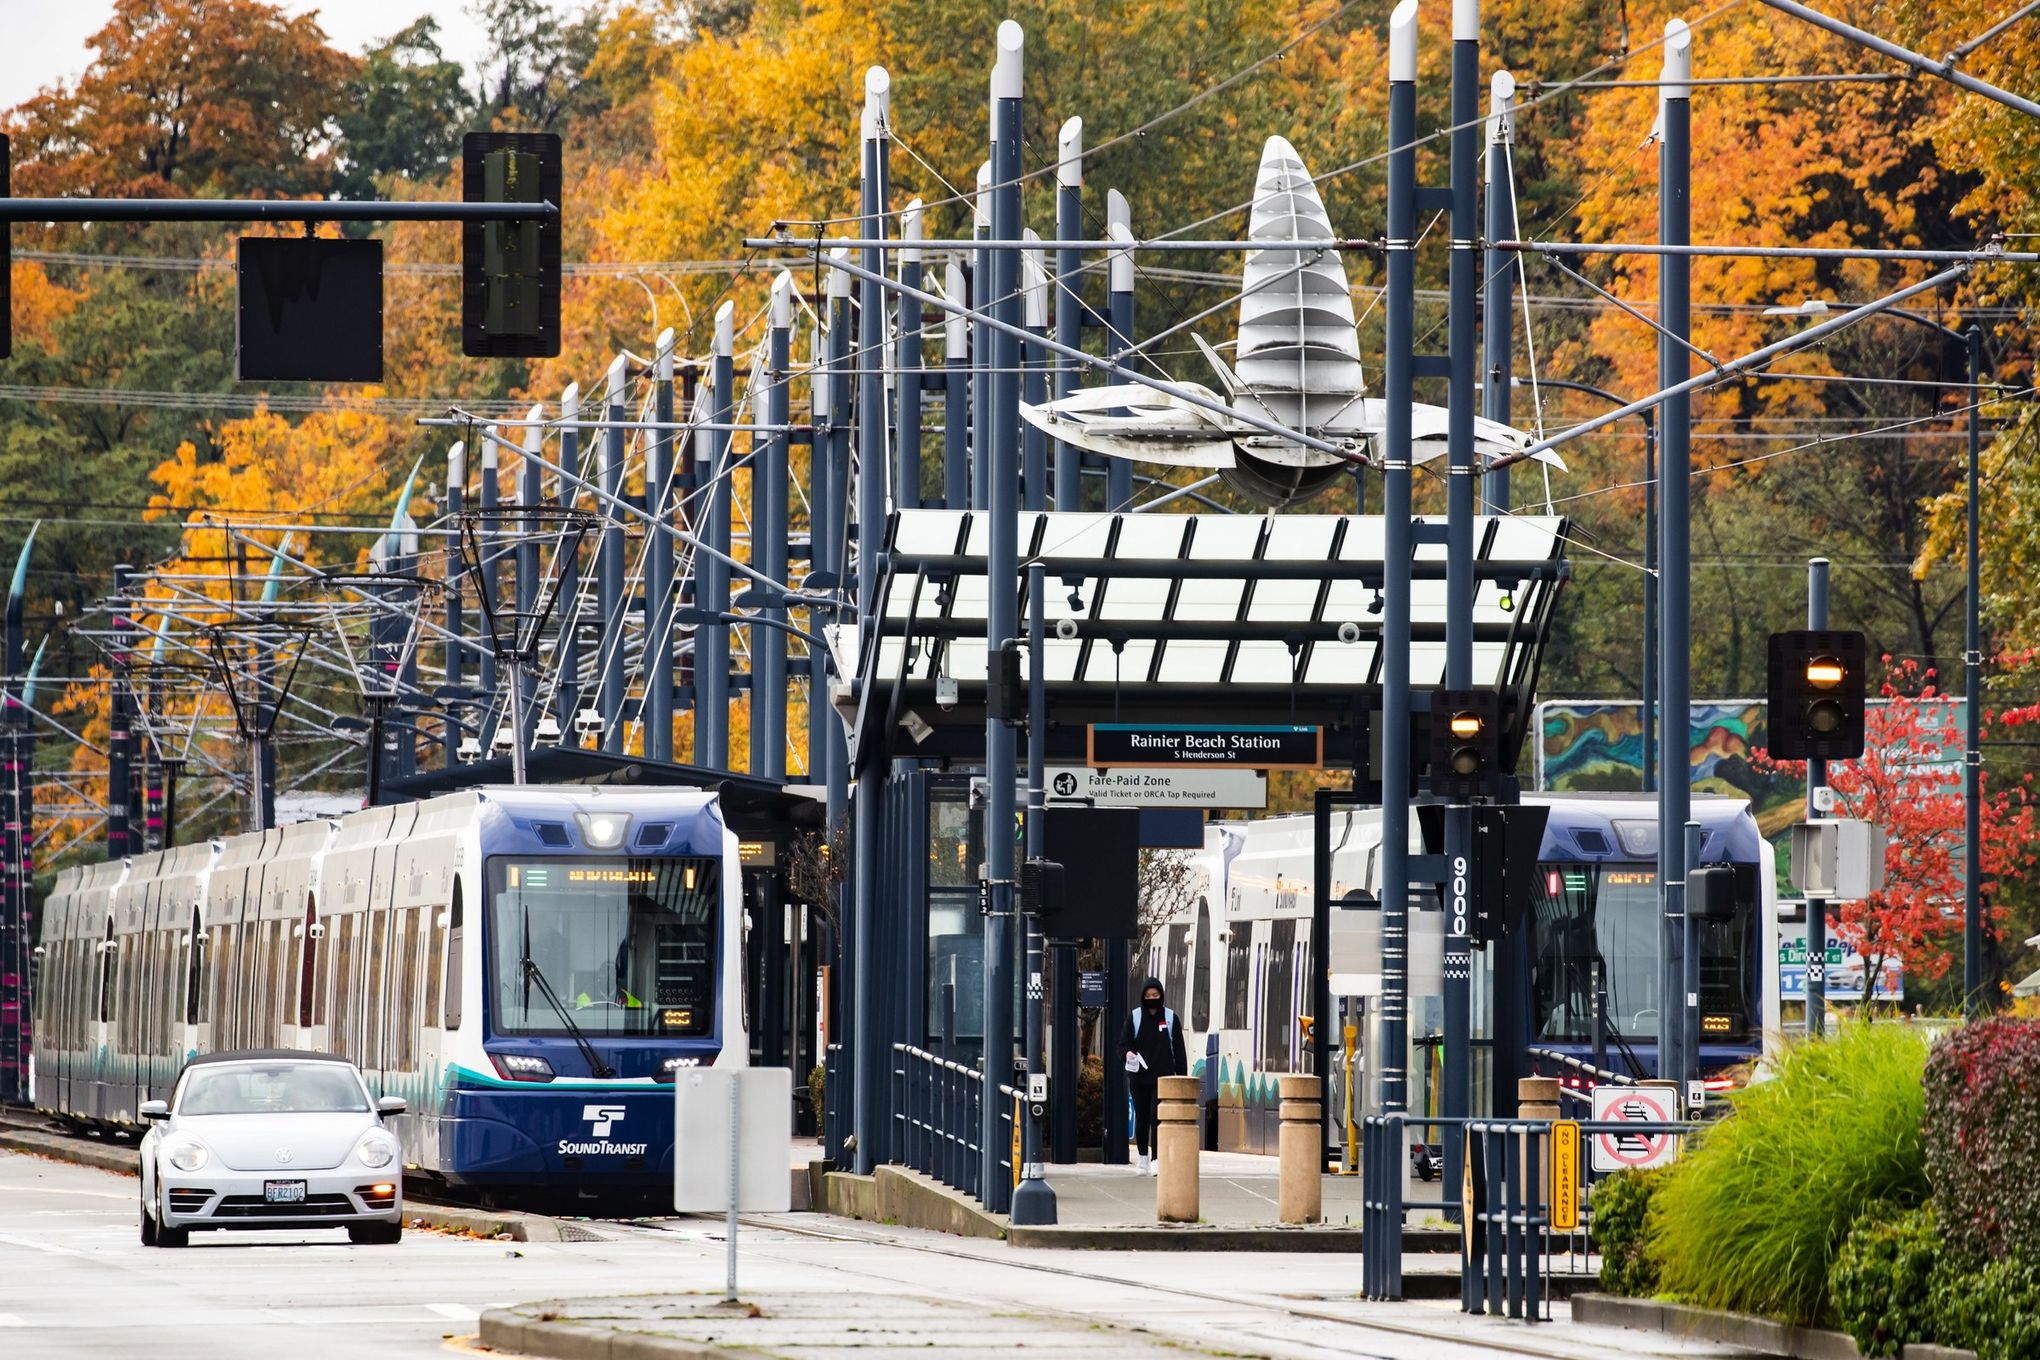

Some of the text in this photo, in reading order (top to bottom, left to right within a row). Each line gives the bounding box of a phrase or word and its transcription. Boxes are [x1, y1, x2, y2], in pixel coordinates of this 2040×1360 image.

[1131, 734, 1281, 749] Rainier Beach Station
[1174, 751, 1236, 759] S Henderson St
[1088, 775, 1171, 786] Fare-Paid Zone
[1089, 790, 1108, 798] Valid
[1110, 790, 1132, 798] Ticket
[1144, 790, 1165, 799] ORCA
[1167, 790, 1180, 800] Tap
[1182, 791, 1216, 800] Required
[1453, 856, 1467, 936] 9000
